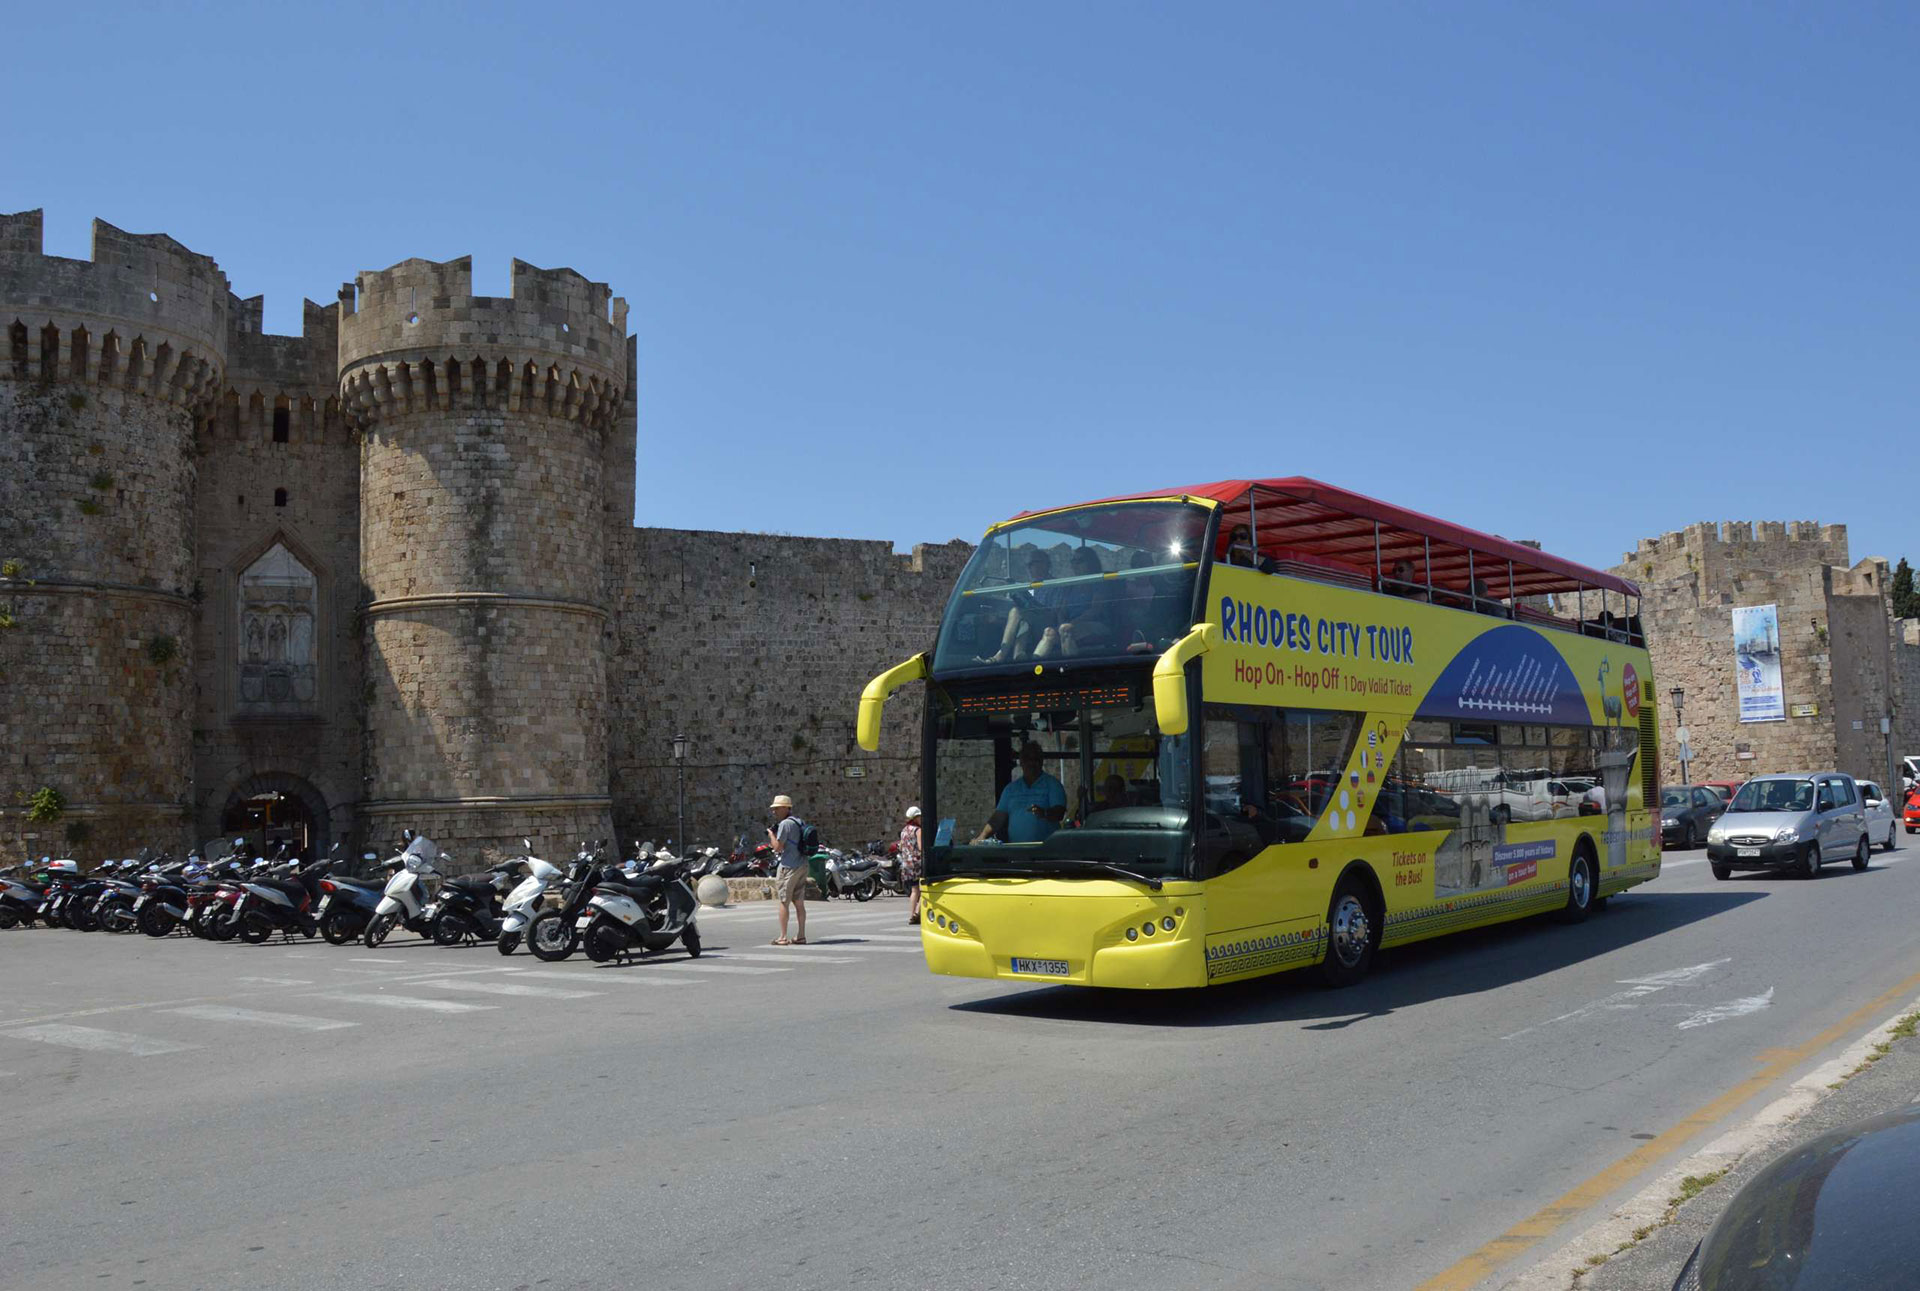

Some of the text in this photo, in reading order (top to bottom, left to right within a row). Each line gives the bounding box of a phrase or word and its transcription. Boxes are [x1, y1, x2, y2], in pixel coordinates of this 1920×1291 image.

[1221, 596, 1414, 665] RHODES CITY TOUR
[1235, 658, 1262, 689] Hop
[1265, 662, 1284, 686] On
[1294, 664, 1320, 693] Hop
[1322, 667, 1340, 690] Off
[1344, 675, 1412, 696] 1 Day Valid Ticket
[1392, 851, 1426, 867] Tickets on
[1395, 869, 1423, 886] the Bus!
